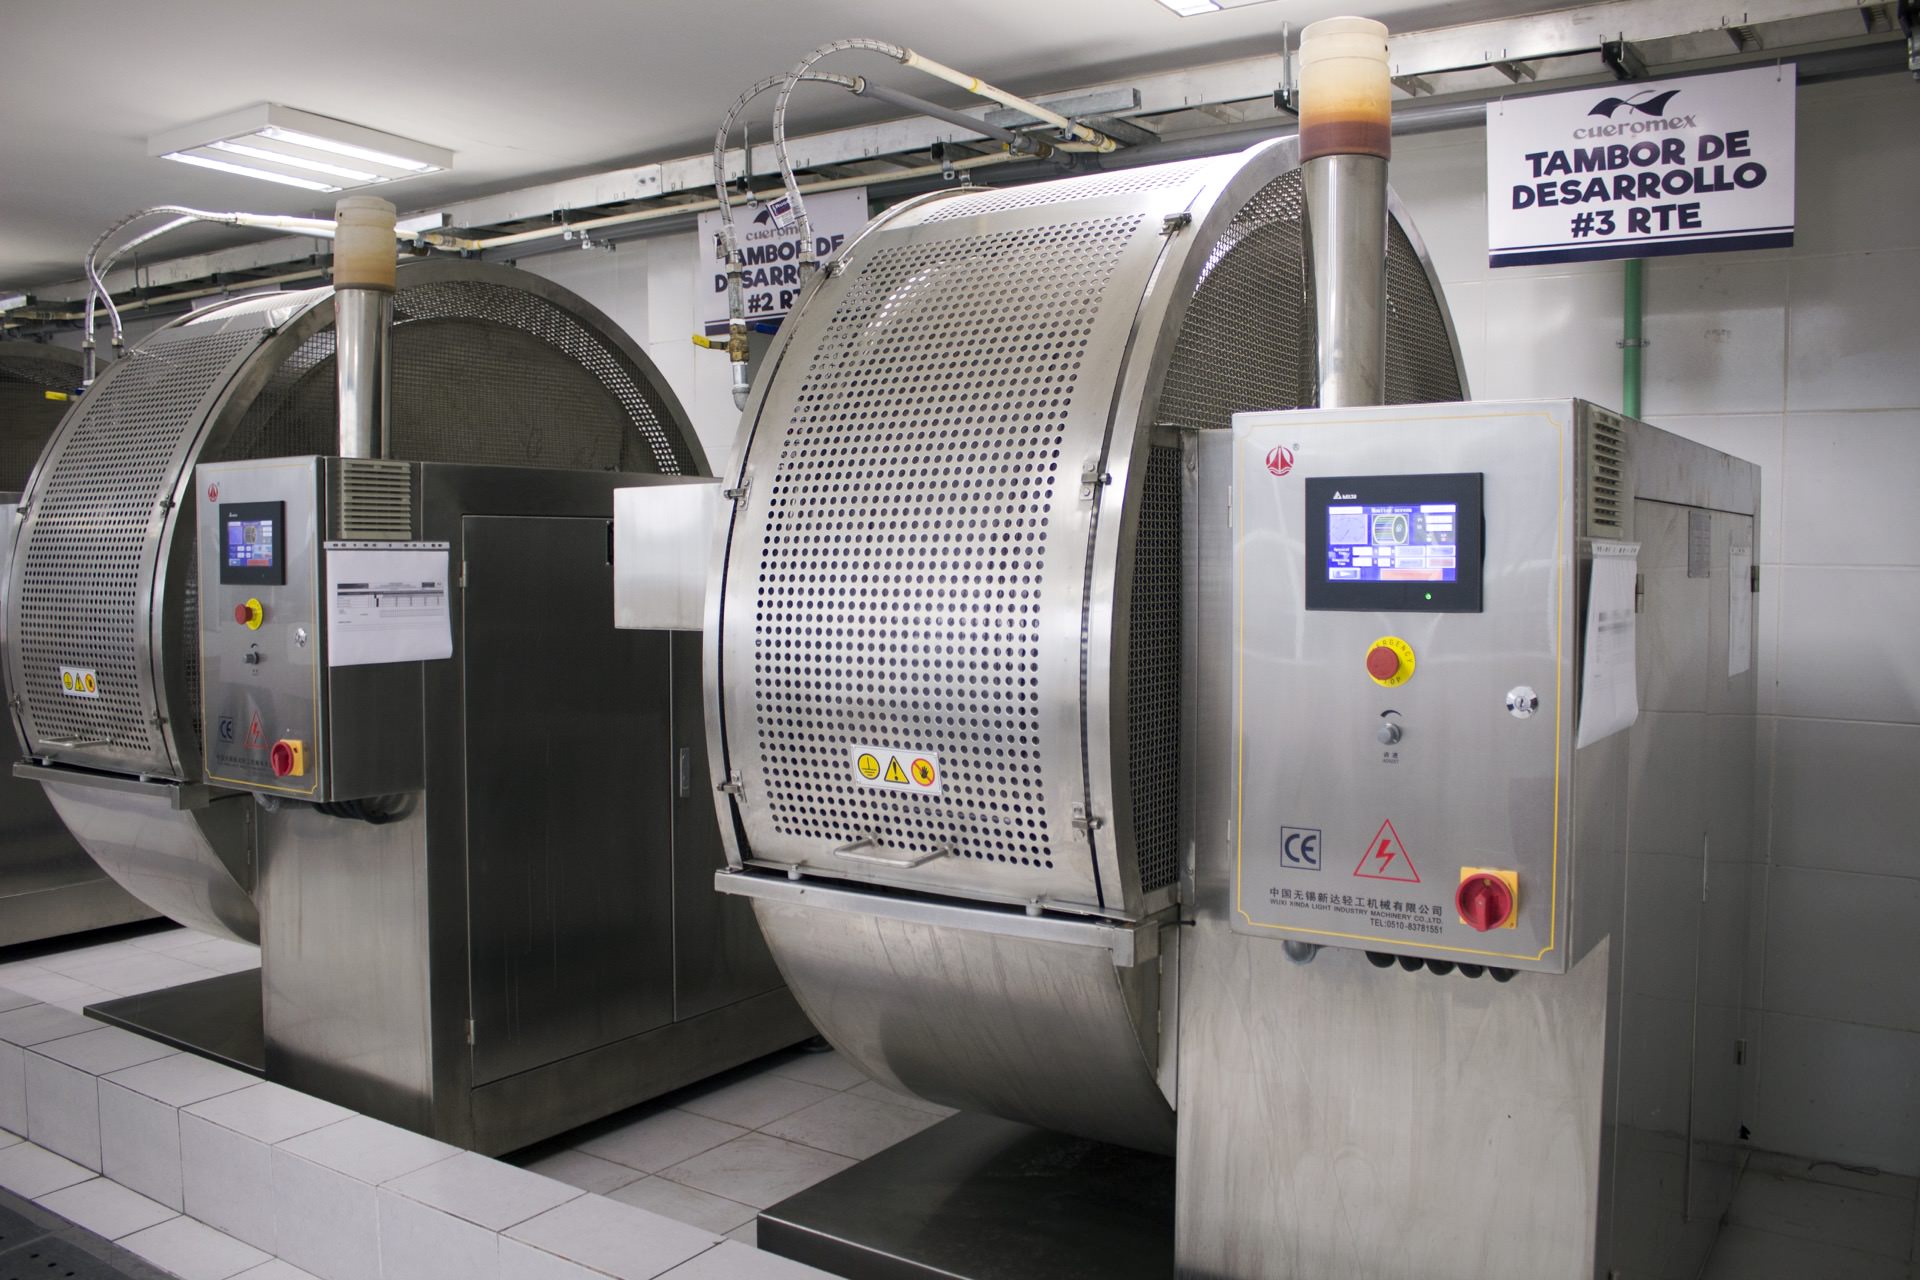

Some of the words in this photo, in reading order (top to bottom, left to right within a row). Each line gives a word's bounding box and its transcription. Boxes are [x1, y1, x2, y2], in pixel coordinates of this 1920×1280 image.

[1573, 114, 1696, 140] cueromex
[1525, 138, 1685, 178] TAMBOR
[1698, 130, 1751, 162] DE
[1512, 162, 1767, 209] DESARROLLO
[746, 222, 814, 241] cueromx
[1571, 210, 1616, 238] #3
[1628, 202, 1702, 234] RTE
[748, 292, 774, 313] #2
[1284, 833, 1317, 864] CE
[1270, 887, 1442, 917] 中国无锡新达轻工机械有限公司
[1334, 906, 1368, 915] INDUSTRY
[1370, 910, 1411, 920] MACHINERY
